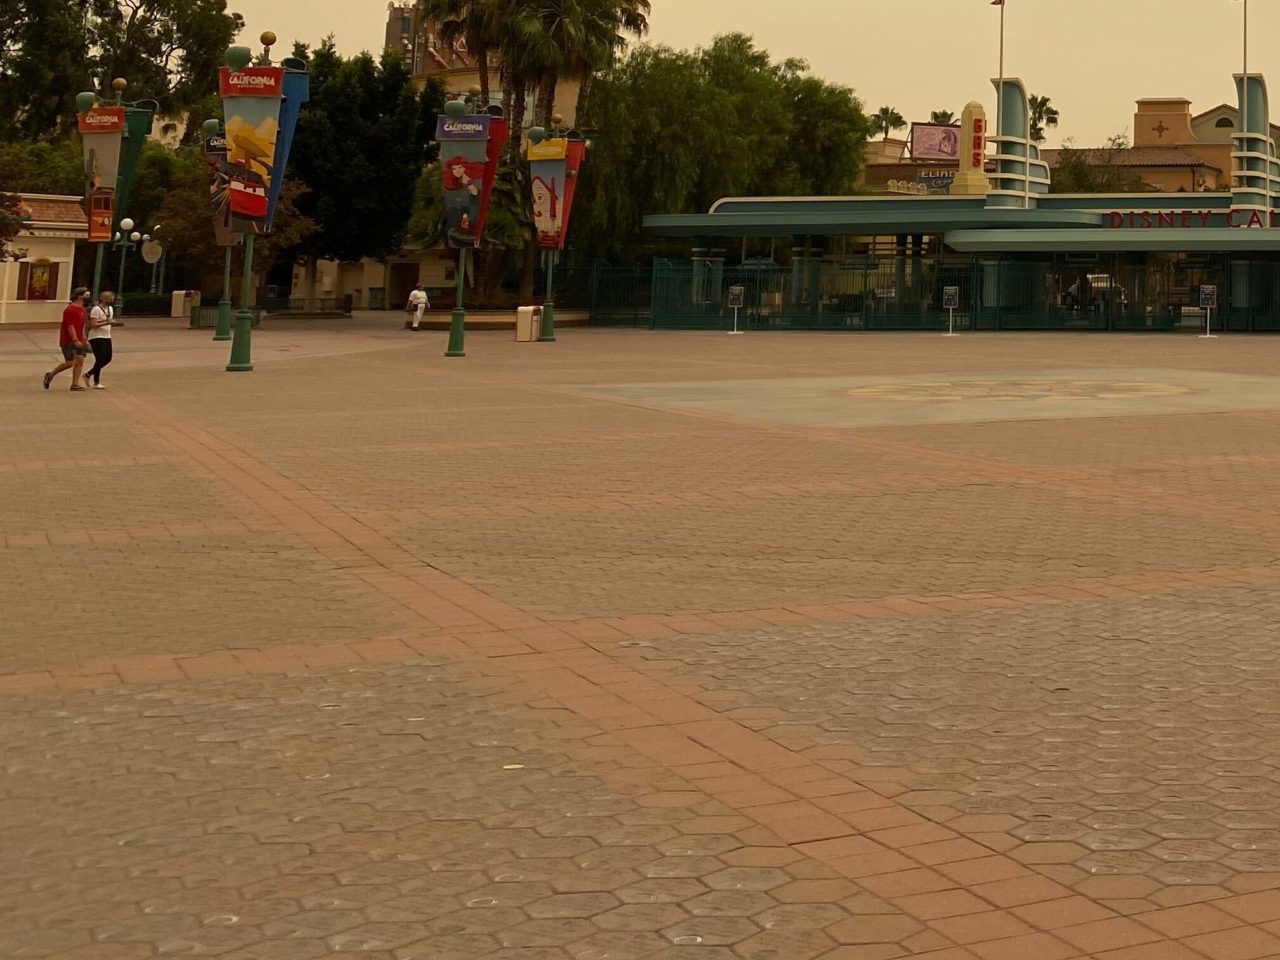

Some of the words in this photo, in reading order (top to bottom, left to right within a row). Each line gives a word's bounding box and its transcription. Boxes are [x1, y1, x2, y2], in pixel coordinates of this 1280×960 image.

[229, 75, 275, 86] CALIFORNIA
[443, 123, 483, 131] CALIFORNIA
[1108, 210, 1212, 229] DISNEY
